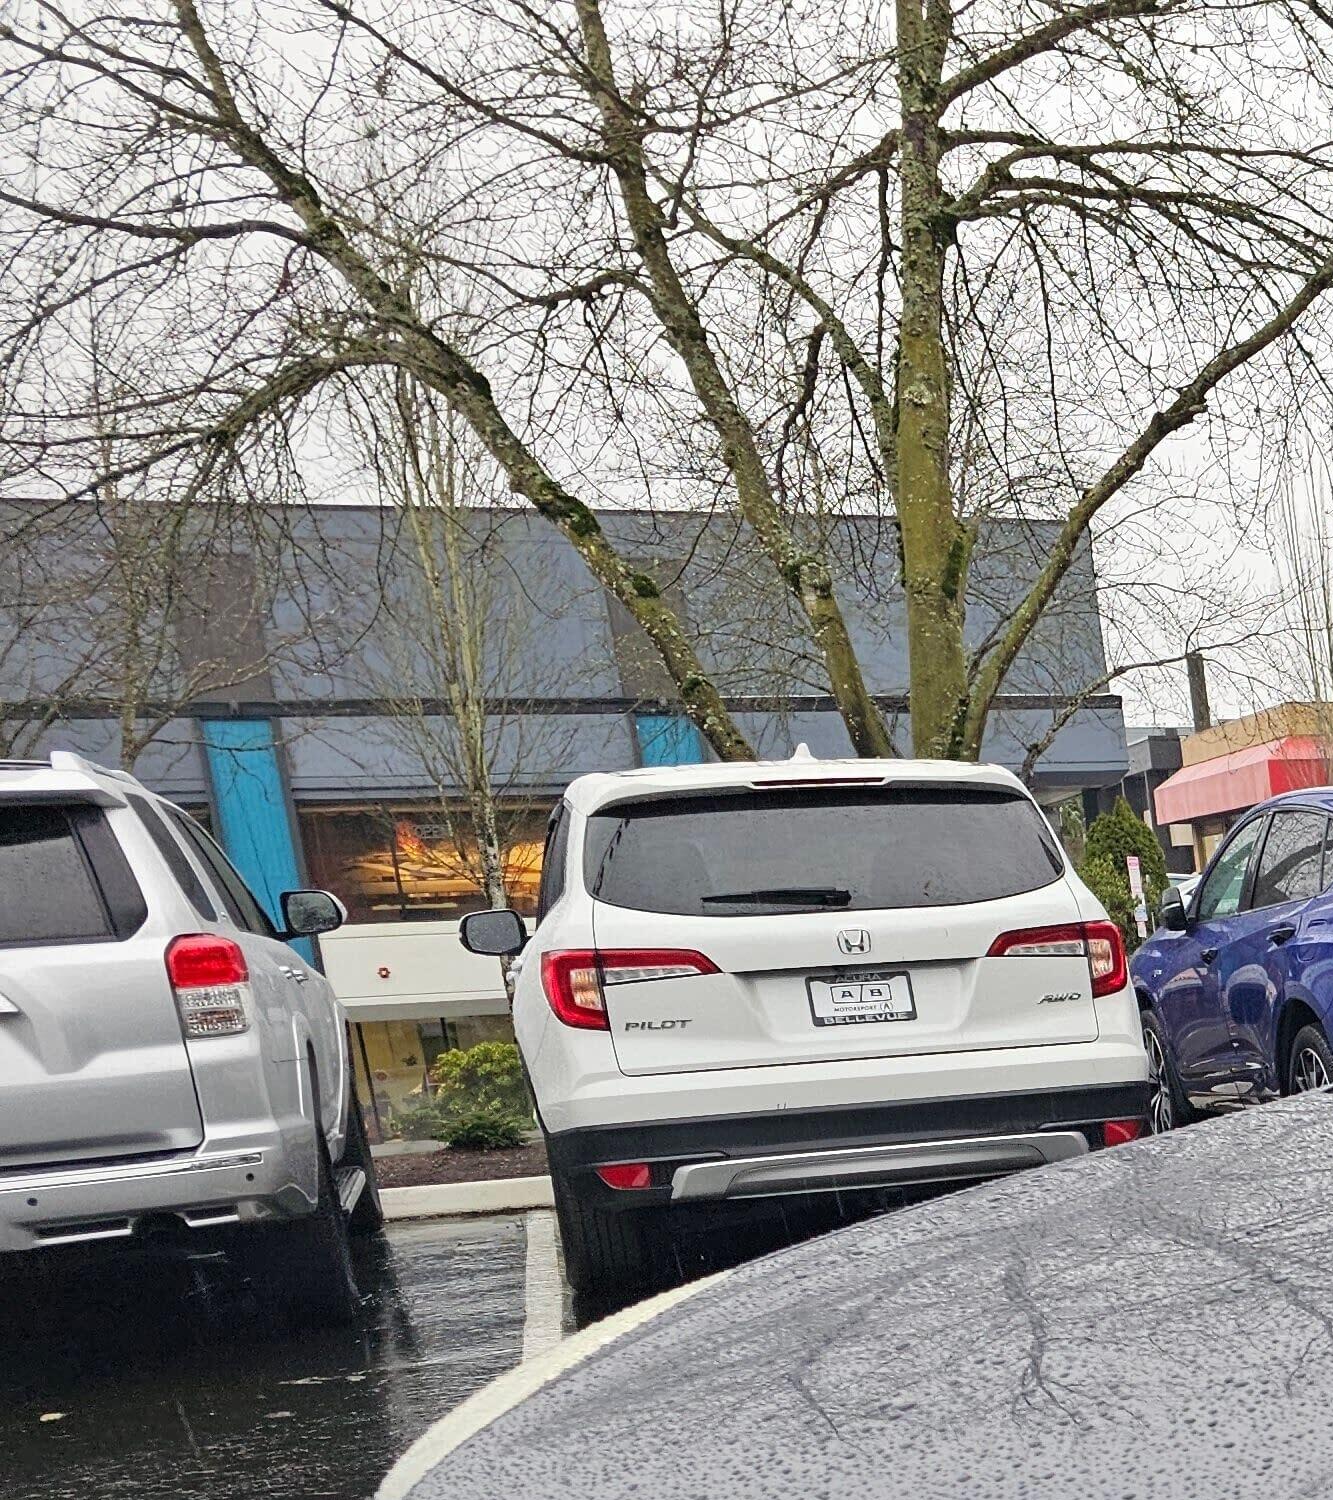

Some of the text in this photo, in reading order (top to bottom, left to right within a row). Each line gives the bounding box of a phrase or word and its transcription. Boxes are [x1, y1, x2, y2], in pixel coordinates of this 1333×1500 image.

[841, 988, 883, 998] A B
[1037, 992, 1082, 1005] AWD
[823, 1012, 911, 1025] BELLEVUE
[624, 1019, 693, 1032] PILOT
